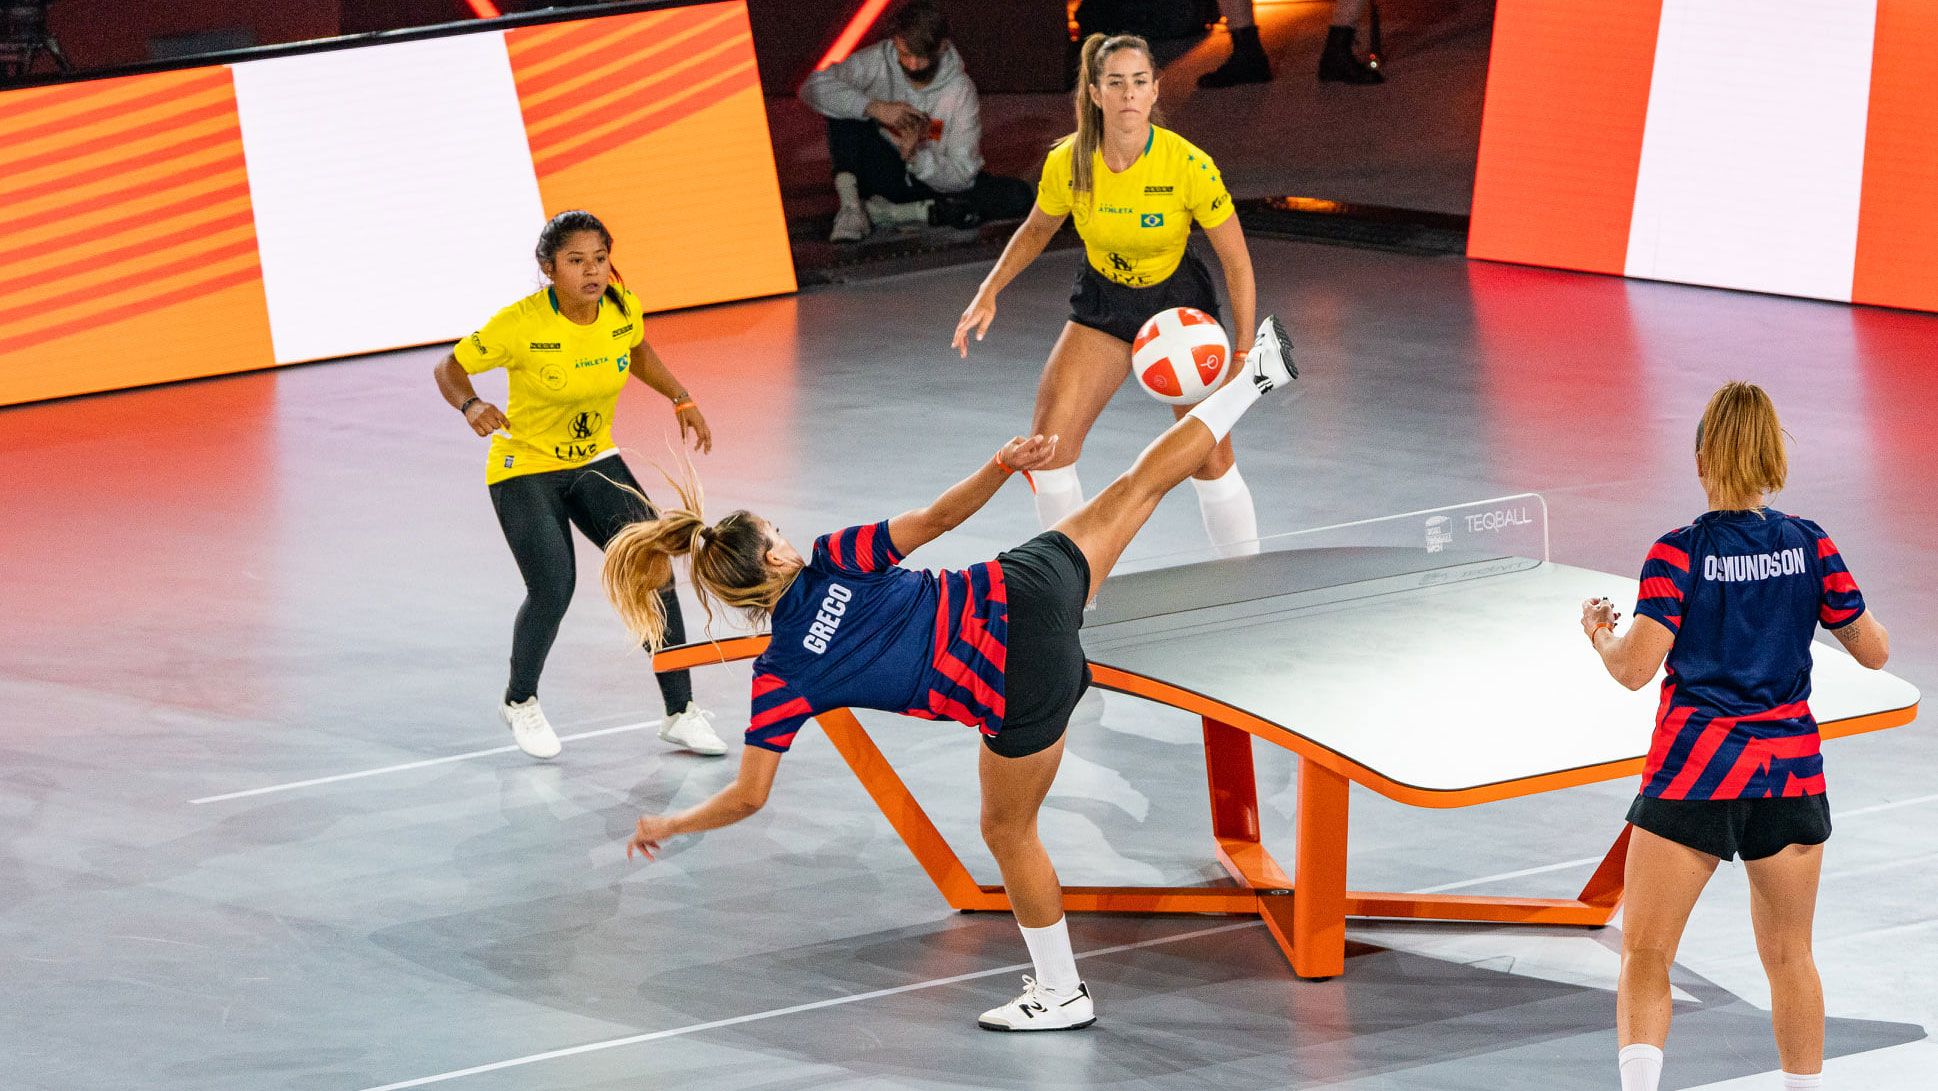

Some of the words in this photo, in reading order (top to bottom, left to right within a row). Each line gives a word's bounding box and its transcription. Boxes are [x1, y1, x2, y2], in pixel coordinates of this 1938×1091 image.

[575, 357, 609, 369] ATHLETA
[554, 443, 597, 460] LIVE
[1464, 507, 1532, 533] TEQBALL
[1704, 547, 1806, 582] OSMUNDSON
[803, 583, 852, 654] GRECO
